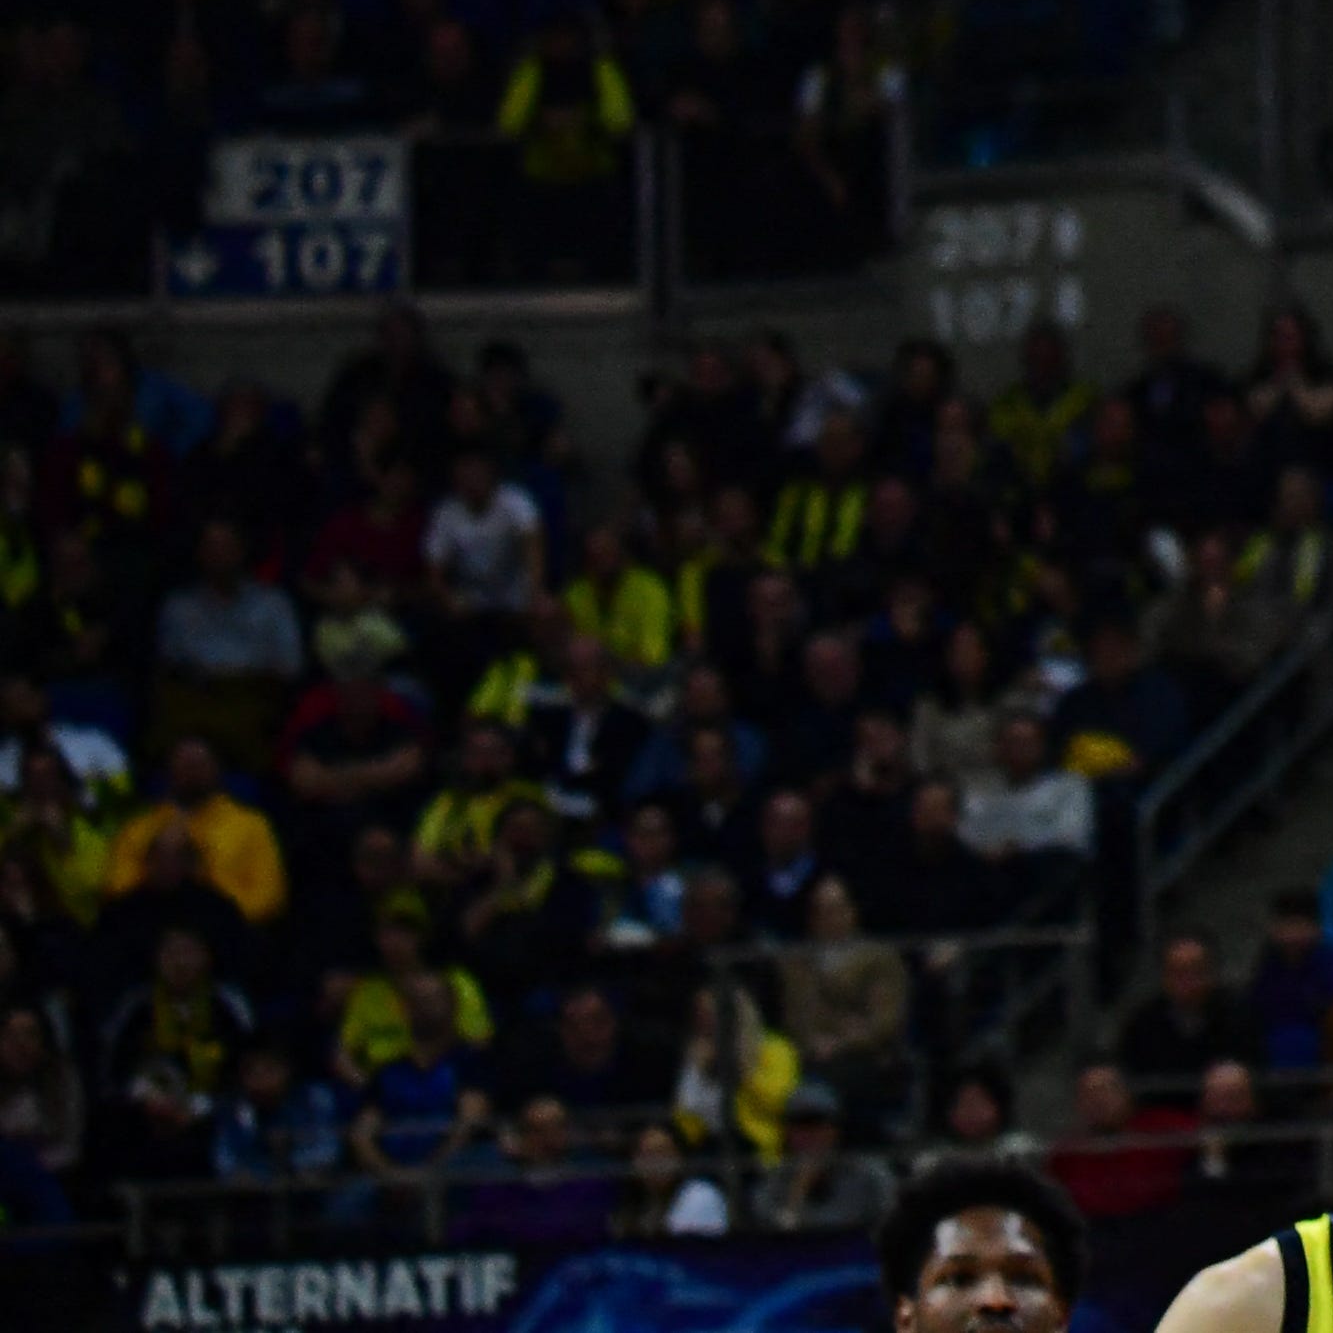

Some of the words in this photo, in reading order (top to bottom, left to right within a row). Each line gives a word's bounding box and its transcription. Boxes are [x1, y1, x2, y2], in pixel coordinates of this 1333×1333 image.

[254, 156, 388, 210] 207
[254, 229, 390, 289] 107
[141, 1251, 518, 1329] ALTERNATIF
